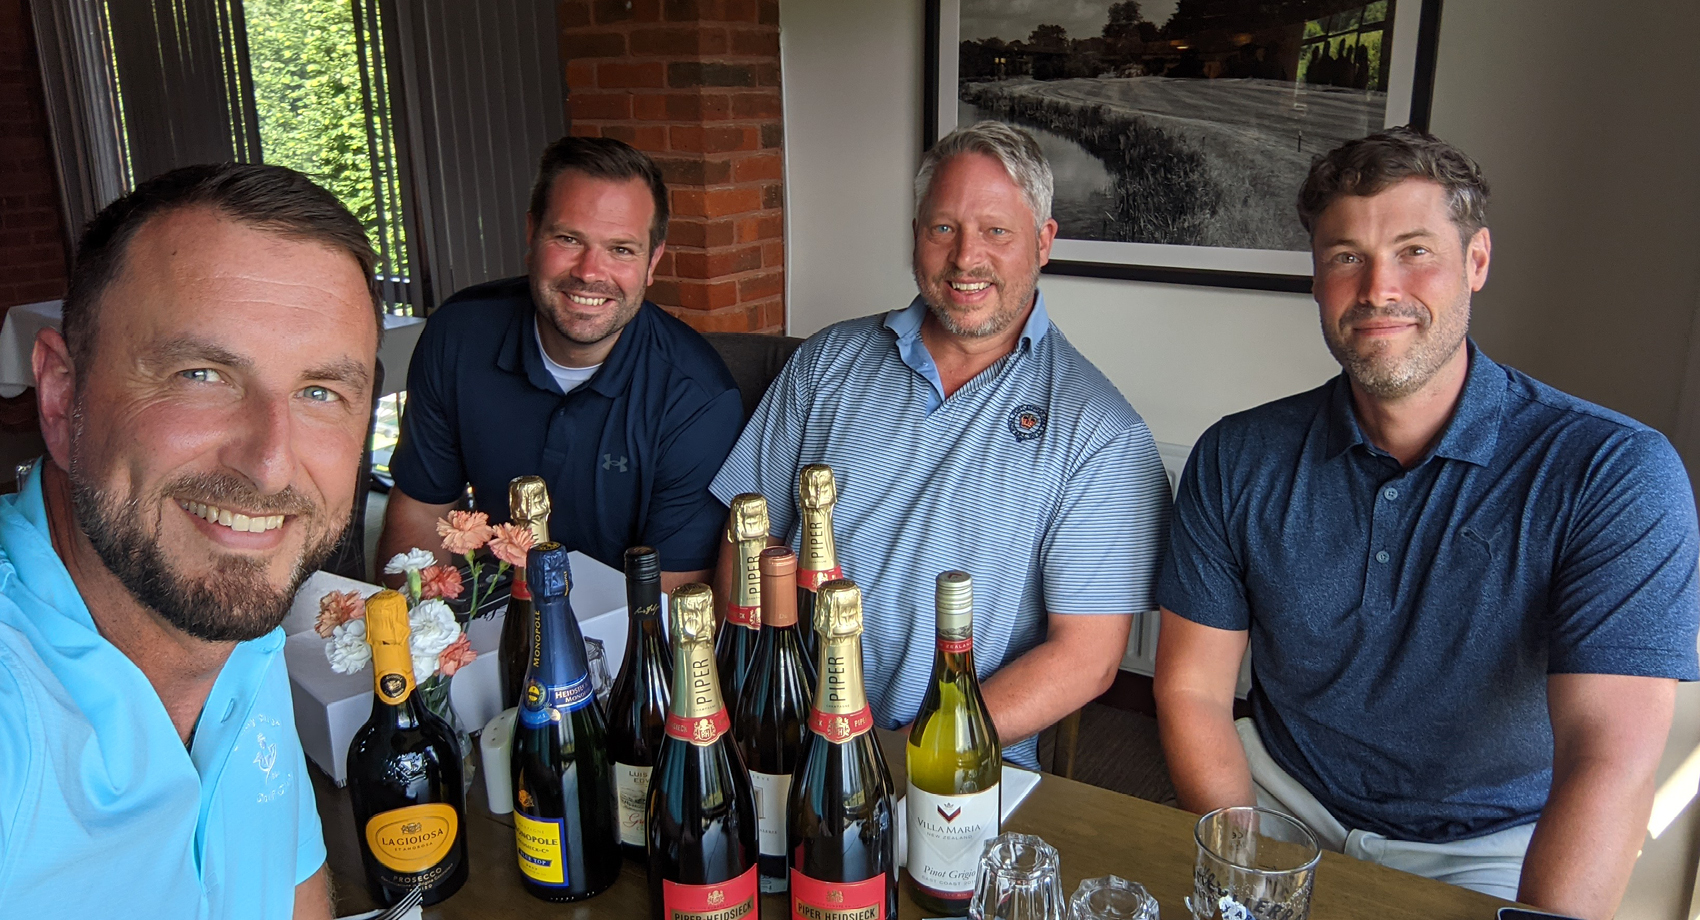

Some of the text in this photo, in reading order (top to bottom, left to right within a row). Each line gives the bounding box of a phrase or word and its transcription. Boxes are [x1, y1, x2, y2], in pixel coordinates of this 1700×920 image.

[810, 521, 824, 559] PIPER
[746, 555, 761, 595] PIPER
[533, 609, 541, 668] MONOPOLE
[692, 657, 713, 706] PIPER
[828, 656, 846, 702] PIPER
[917, 817, 981, 834] VILLA MARIA
[393, 867, 442, 883] PROSECCO
[921, 875, 937, 883] EAST
[924, 865, 976, 881] Pinot Grigio
[798, 902, 820, 919] PIPER
[825, 908, 876, 920] HEIDSIECK
